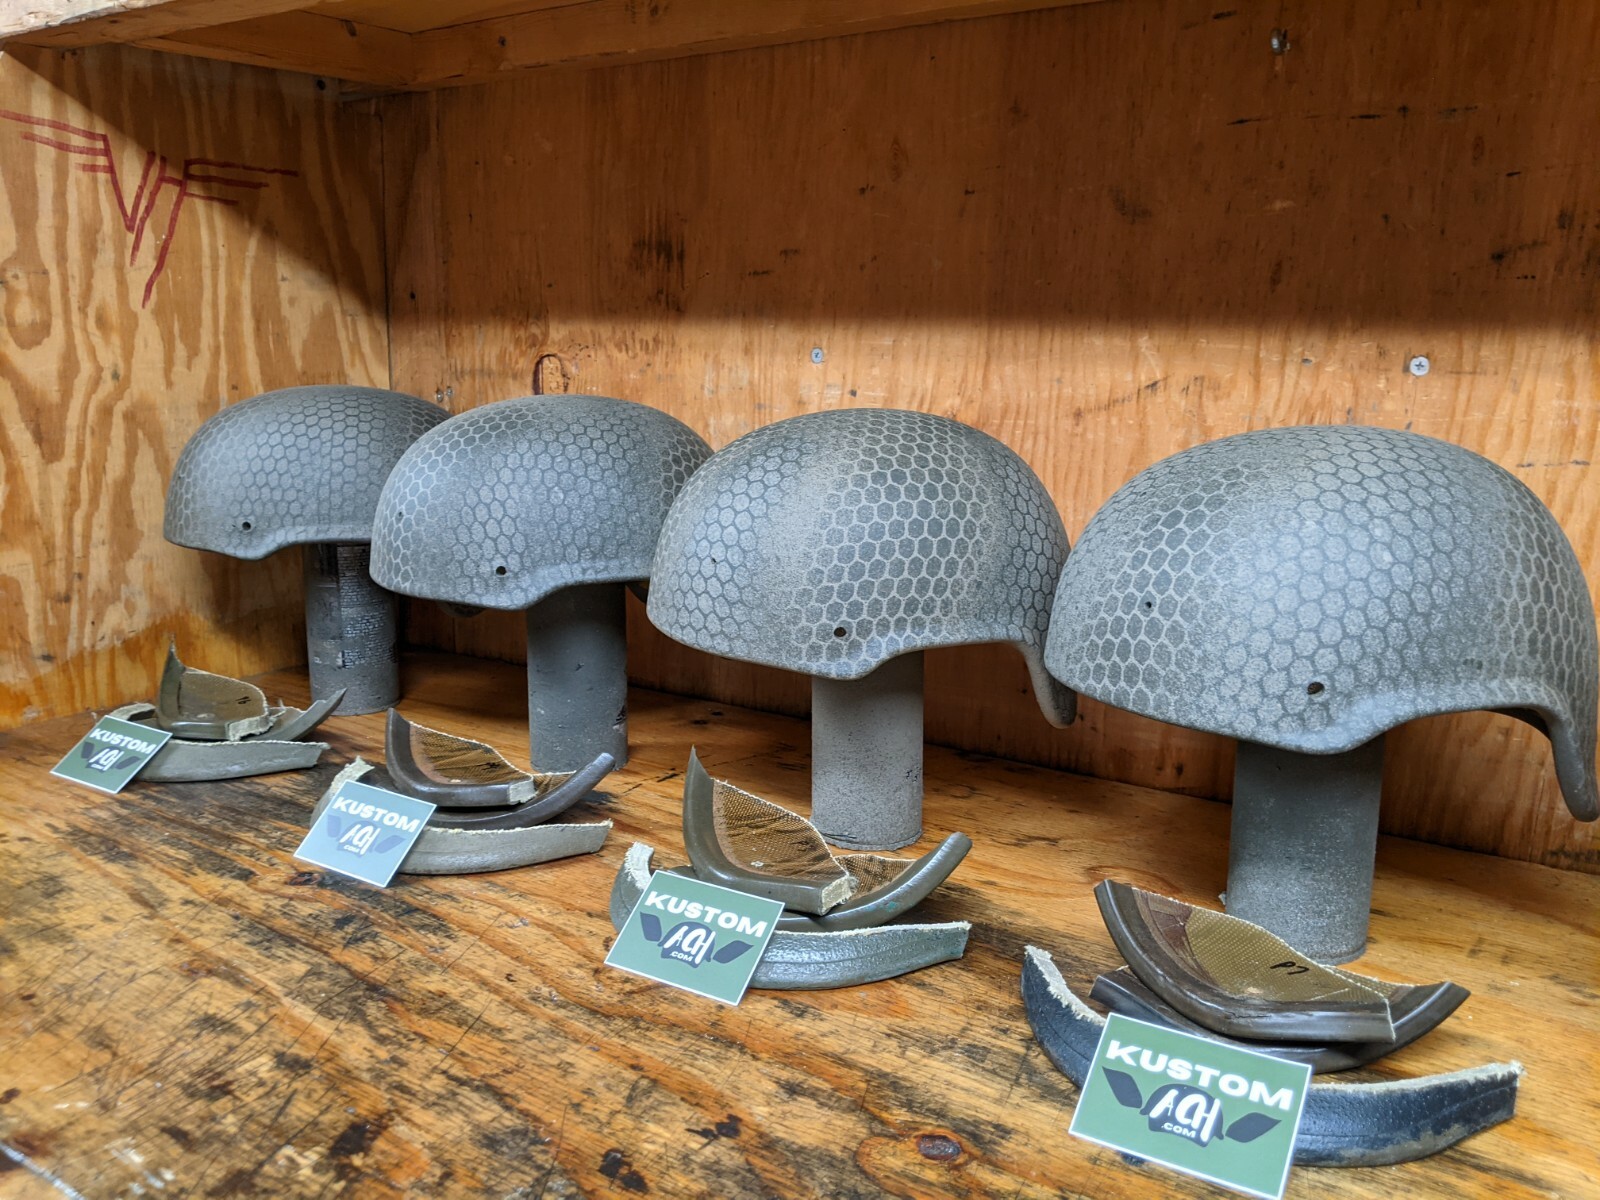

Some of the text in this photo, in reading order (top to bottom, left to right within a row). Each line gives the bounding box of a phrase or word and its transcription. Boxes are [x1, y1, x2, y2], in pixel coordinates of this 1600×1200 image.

[89, 728, 157, 754] KUSTOM
[332, 796, 420, 833] KUSTOM
[644, 891, 768, 938] KUSTOM
[670, 951, 694, 962] .COM
[1105, 1040, 1294, 1111] KUSTOM
[1161, 1122, 1196, 1138] .COM
